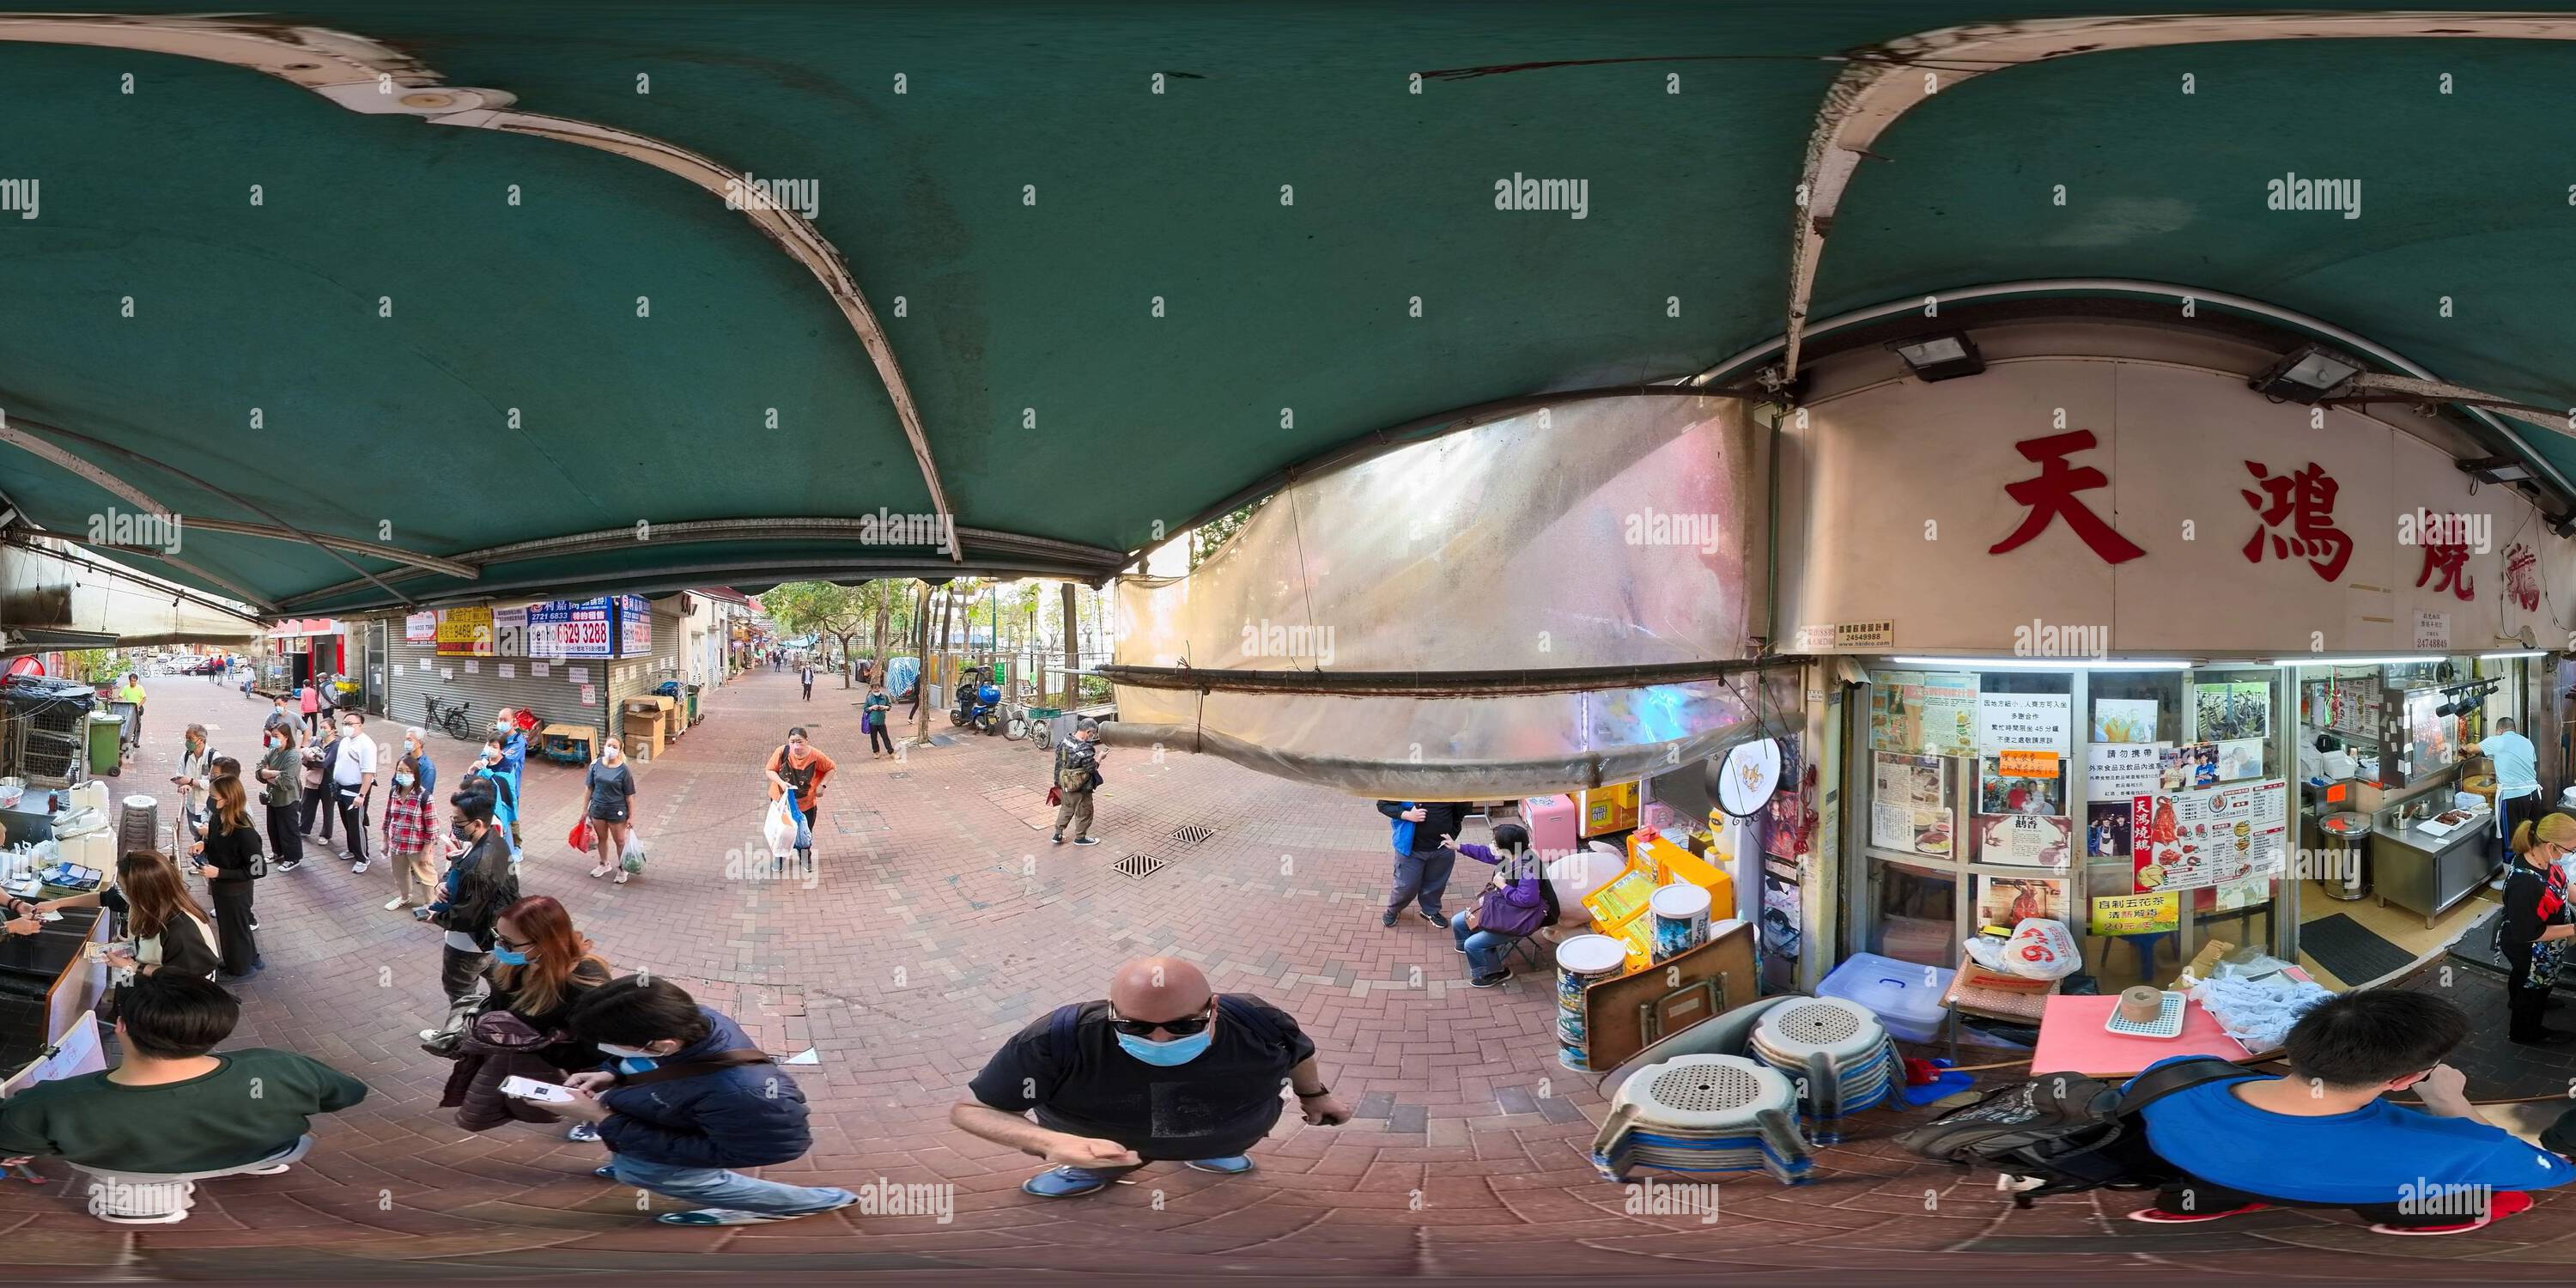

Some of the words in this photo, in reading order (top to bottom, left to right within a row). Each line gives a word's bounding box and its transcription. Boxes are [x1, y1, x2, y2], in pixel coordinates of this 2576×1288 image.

[558, 623, 580, 644] 6629
[583, 623, 607, 644] 3288
[1592, 805, 1608, 813] PRIZE
[1592, 812, 1607, 822] OUT
[2134, 799, 2151, 851] 天鴻燒鵝
